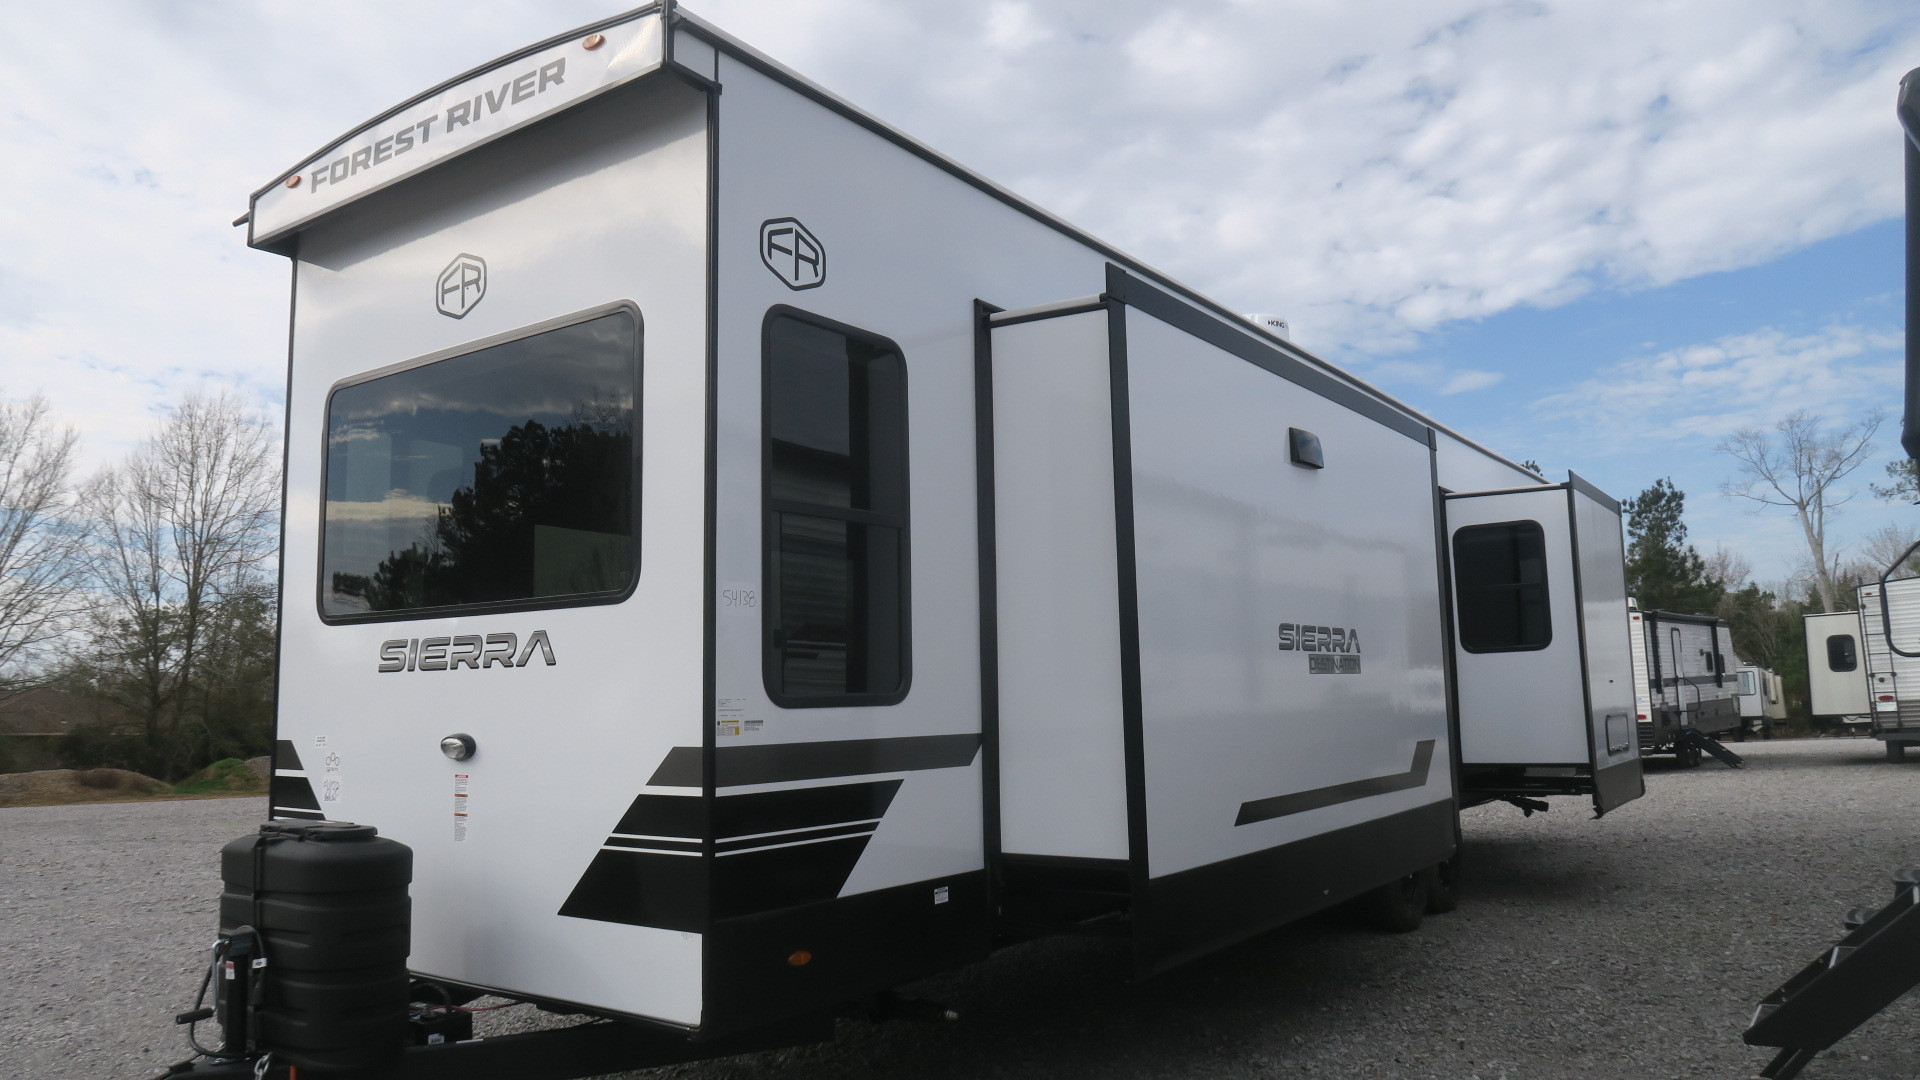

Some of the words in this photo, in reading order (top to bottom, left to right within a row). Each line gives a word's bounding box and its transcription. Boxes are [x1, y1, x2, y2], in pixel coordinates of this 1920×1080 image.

[310, 114, 438, 194] FOREST
[446, 57, 567, 133] RIVER
[722, 589, 757, 608] 54138
[378, 629, 557, 673] SIERRA
[1278, 622, 1361, 654] SIERRA
